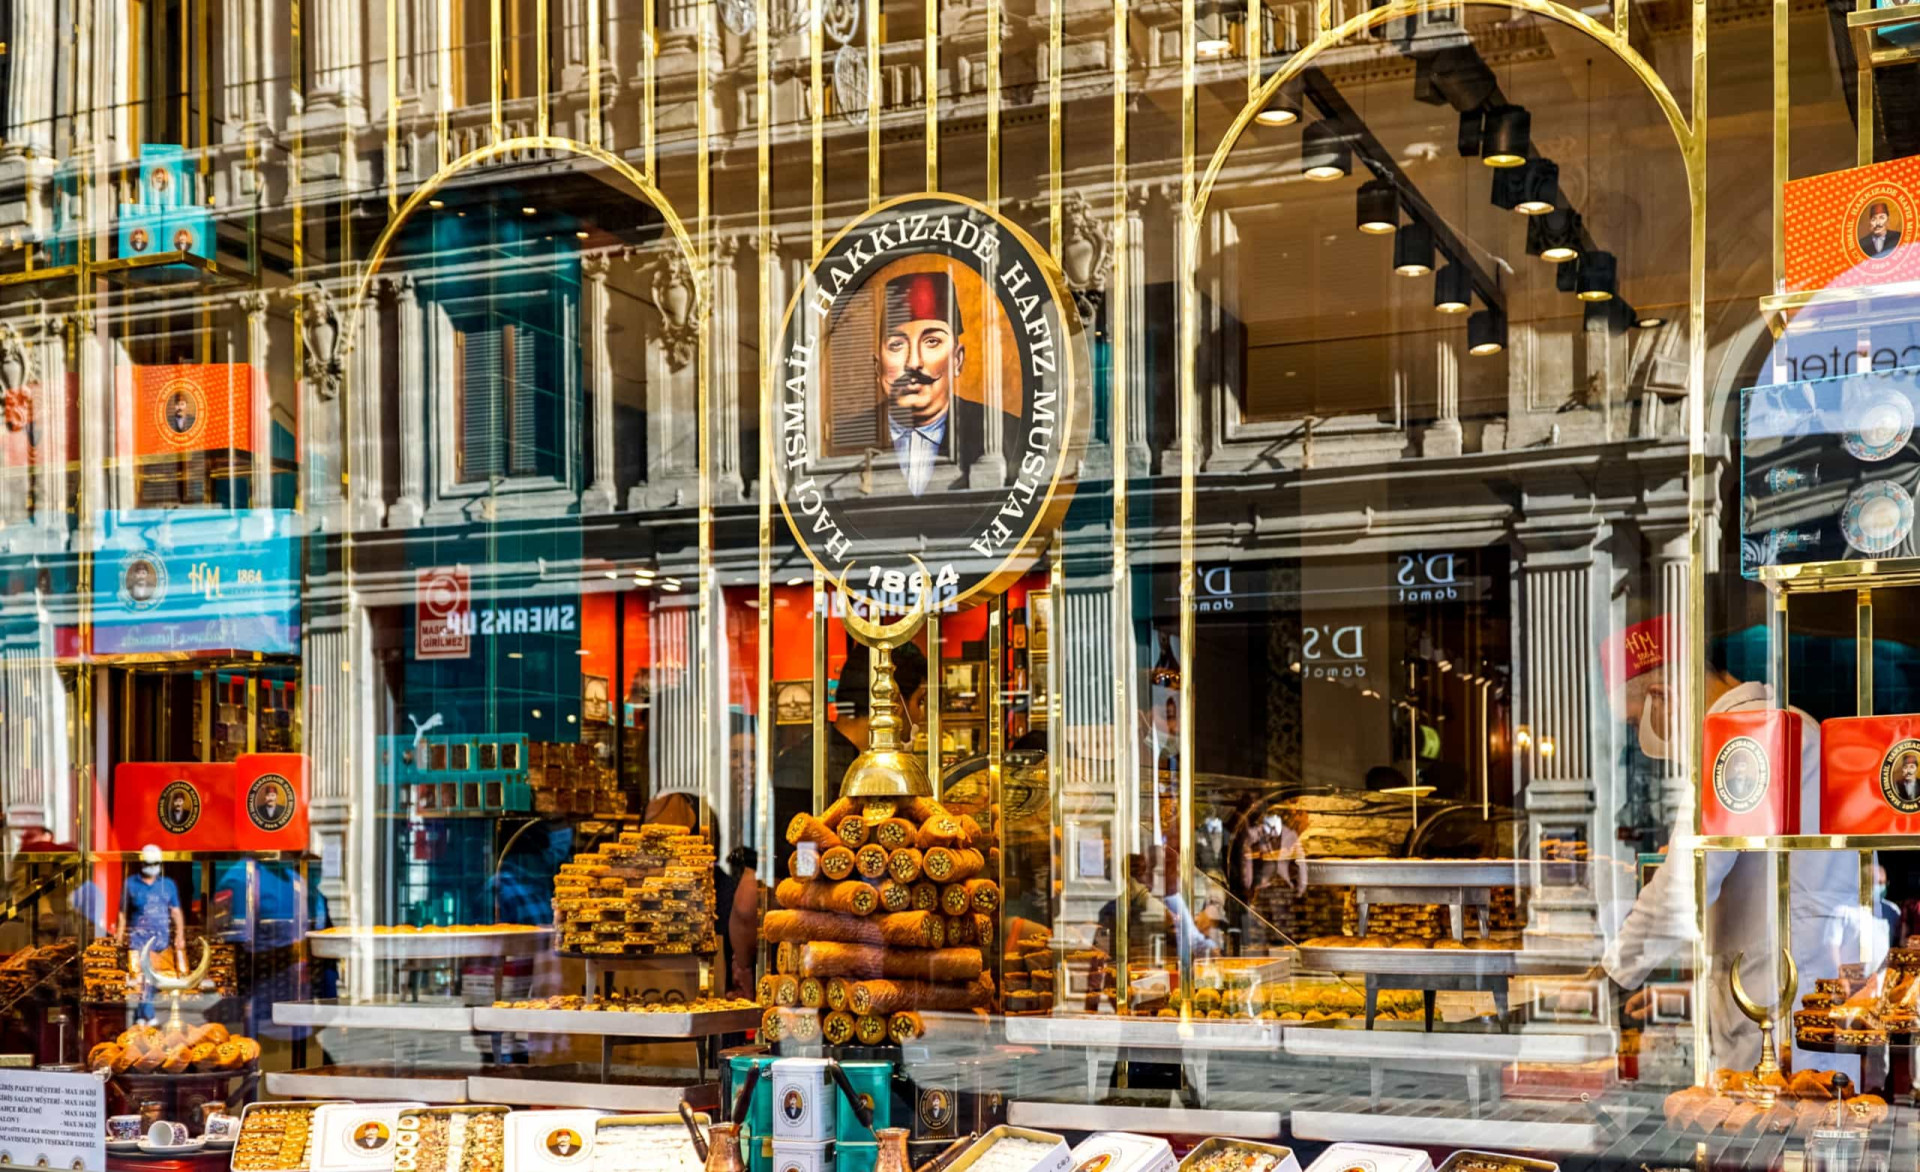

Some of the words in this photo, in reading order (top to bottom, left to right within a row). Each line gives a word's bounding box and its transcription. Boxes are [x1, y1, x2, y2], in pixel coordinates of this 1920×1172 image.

[810, 214, 1000, 318] HAKKIZADE
[1000, 260, 1056, 376] HAFIZ
[783, 335, 816, 471] İSMAİL
[970, 389, 1056, 558] MUSTAFA
[795, 476, 853, 563] HACI
[237, 569, 263, 584] 1864
[867, 563, 960, 593] 1864
[34, 1096, 60, 1105] MÜŞTERİ
[35, 1085, 60, 1094] MÜŞTERİ
